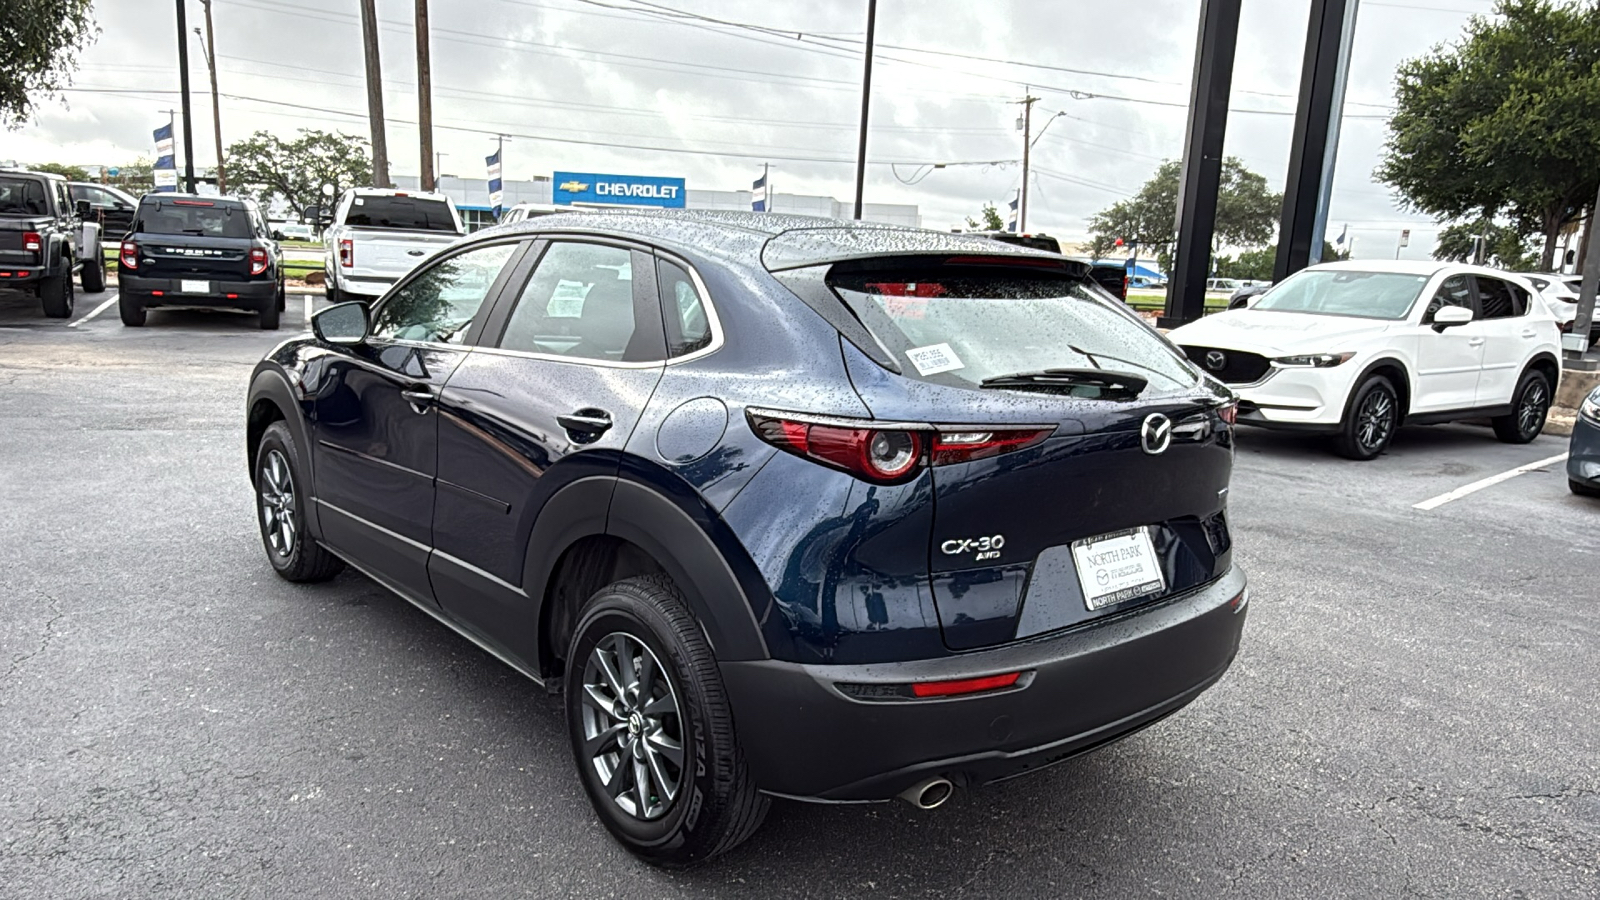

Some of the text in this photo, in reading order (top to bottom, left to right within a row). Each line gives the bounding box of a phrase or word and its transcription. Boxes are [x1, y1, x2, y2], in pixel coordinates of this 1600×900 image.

[595, 182, 679, 199] CHEVROLET
[941, 534, 1005, 554] CX-30
[975, 551, 1001, 561] AWD
[1086, 544, 1143, 569] NORTH PARK
[1092, 588, 1134, 608] NORTH PARK
